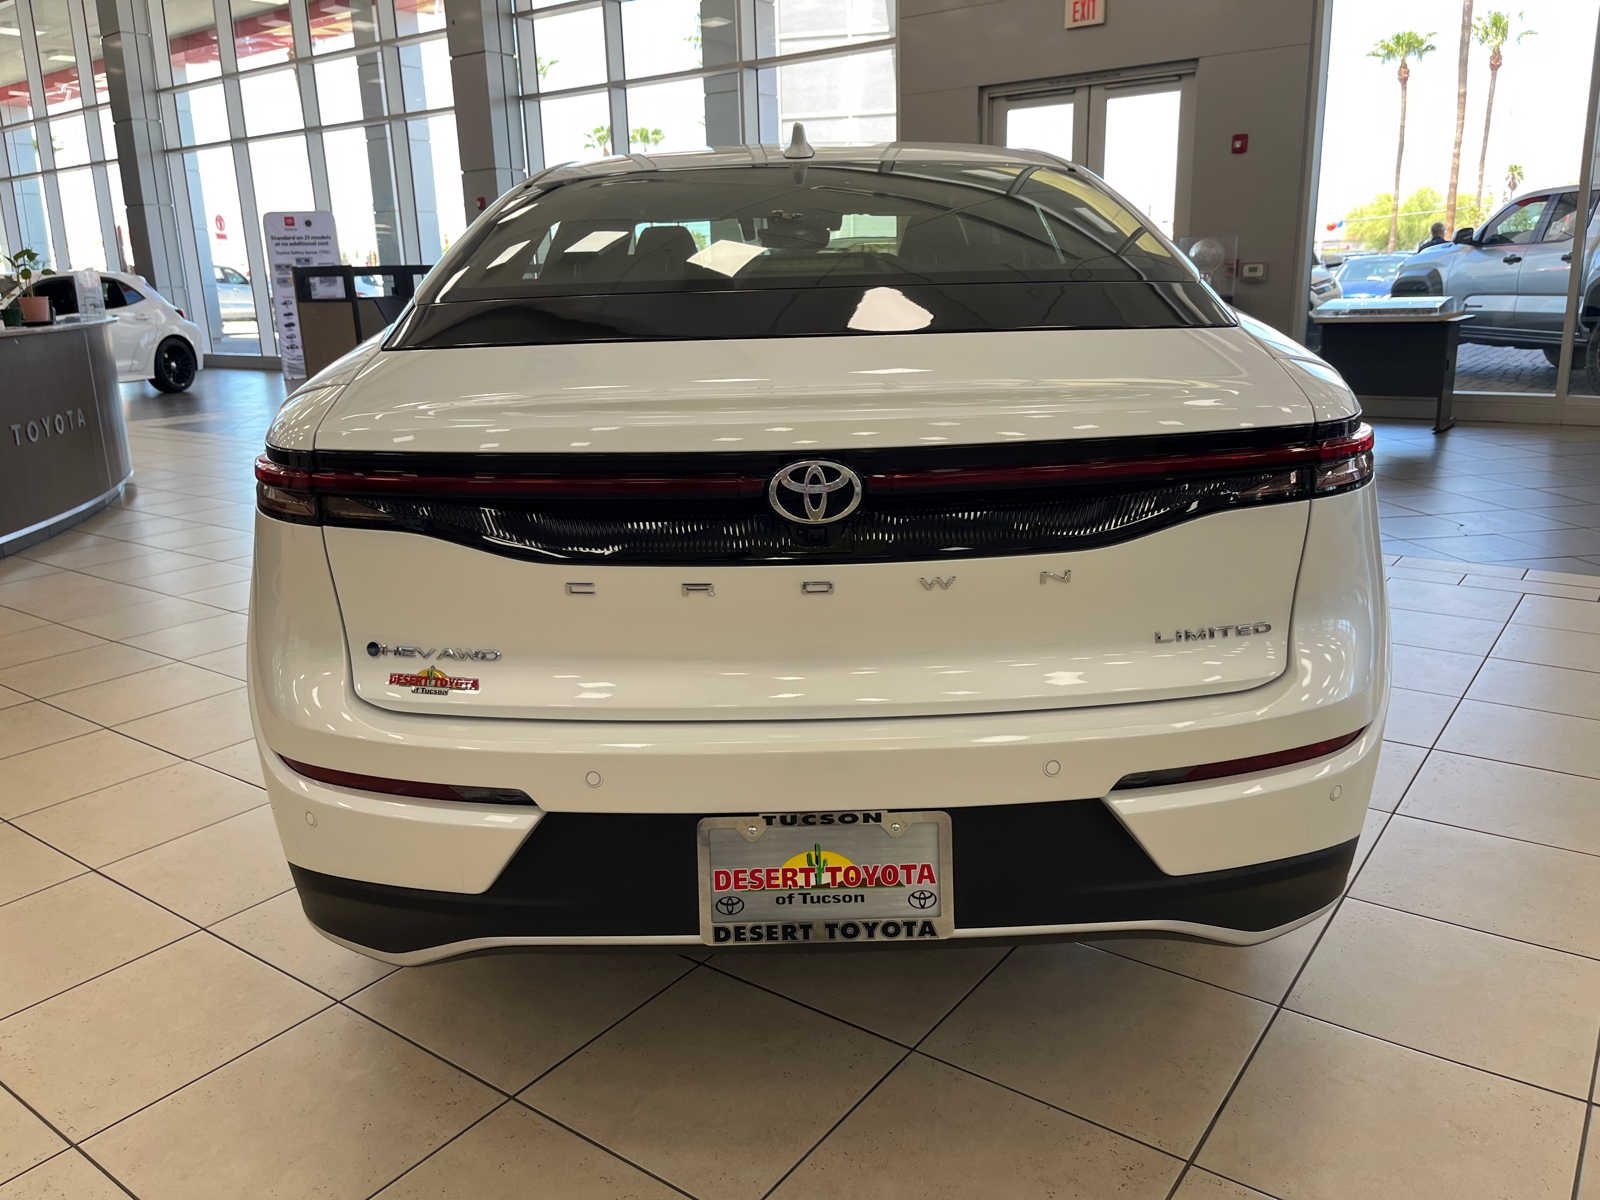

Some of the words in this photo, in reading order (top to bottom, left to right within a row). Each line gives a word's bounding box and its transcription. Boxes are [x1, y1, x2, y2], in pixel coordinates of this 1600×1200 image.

[1072, 0, 1097, 23] EXIT
[9, 407, 86, 446] TOYOTA
[564, 569, 1072, 597] CROWN
[1154, 621, 1272, 644] LIMITED
[389, 673, 431, 686] DESERT
[434, 676, 479, 690] TOYOTA
[420, 687, 449, 696] Tucson
[762, 812, 883, 826] TUCSON
[713, 866, 816, 891] DESERT
[825, 863, 937, 888] TOYOTA
[775, 893, 795, 906] of
[798, 892, 866, 905] Tucson
[712, 923, 813, 943] DESERT
[824, 920, 938, 941] TOYOTA
